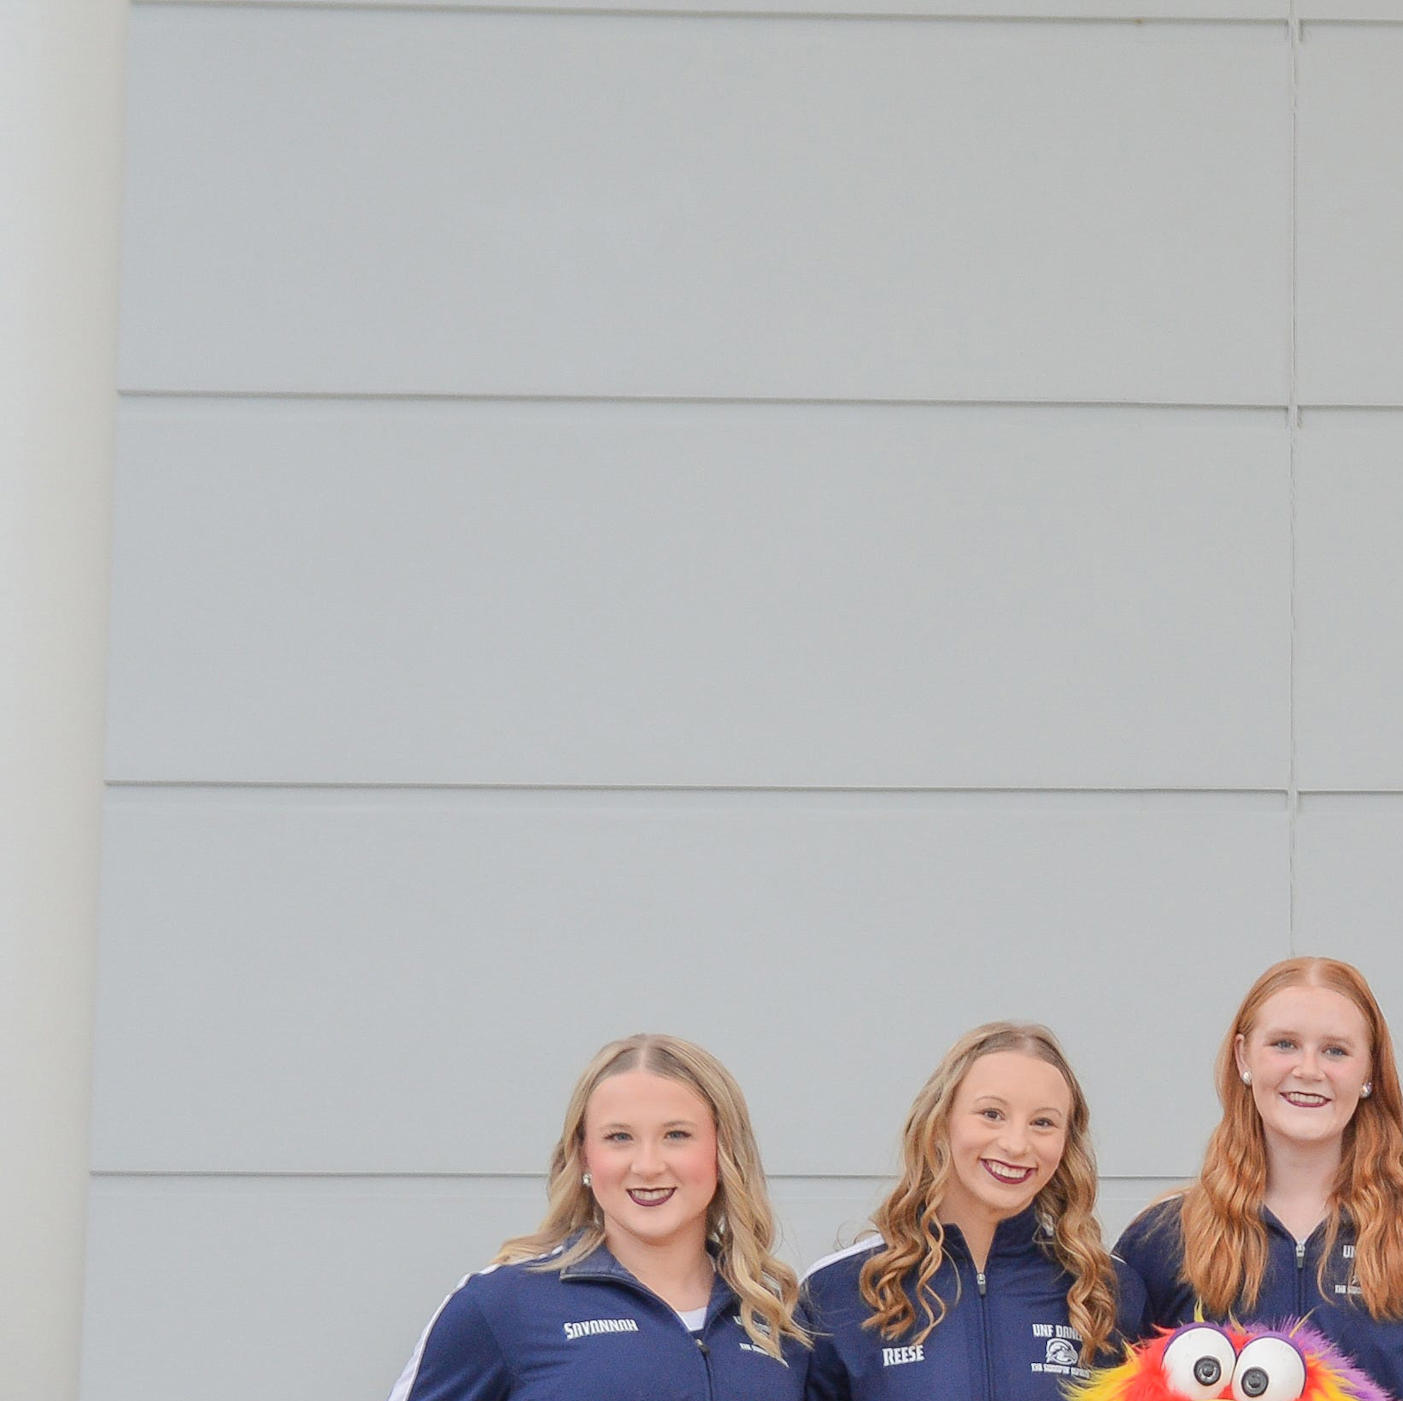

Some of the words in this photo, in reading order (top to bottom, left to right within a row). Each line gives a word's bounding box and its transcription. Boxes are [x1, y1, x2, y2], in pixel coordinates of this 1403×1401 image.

[563, 1318, 639, 1341] SAVANNAH
[1032, 1323, 1054, 1338] UNF
[882, 1344, 926, 1367] REESE
